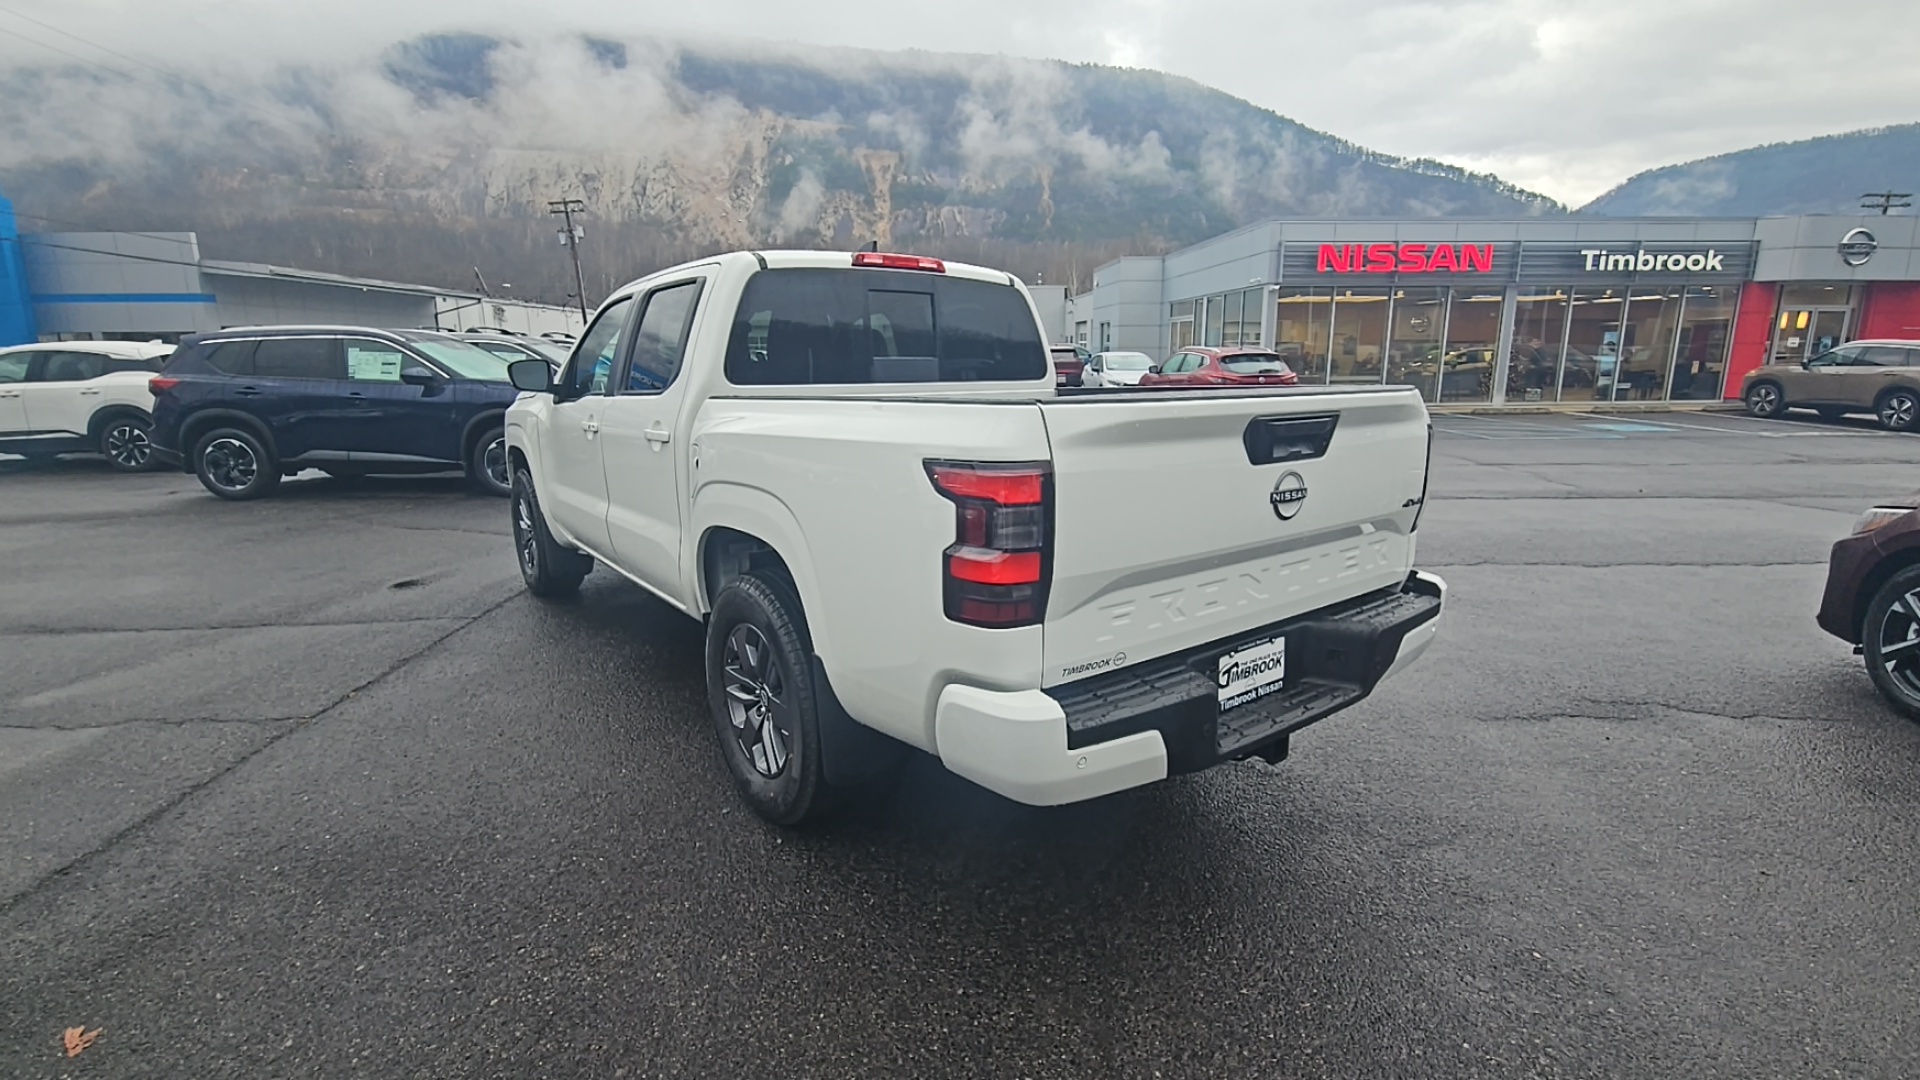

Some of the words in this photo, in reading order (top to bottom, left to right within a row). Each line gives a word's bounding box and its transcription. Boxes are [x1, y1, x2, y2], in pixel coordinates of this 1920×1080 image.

[1316, 243, 1494, 273] NISSAN
[1581, 249, 1723, 272] Timbrook
[1272, 489, 1307, 502] NISSAN
[1096, 538, 1391, 642] FRONTIER
[1062, 658, 1112, 677] TIMBROOK
[1218, 655, 1283, 689] TIMBROOK
[1220, 690, 1257, 711] Timbrook
[1257, 681, 1283, 697] Nissan
